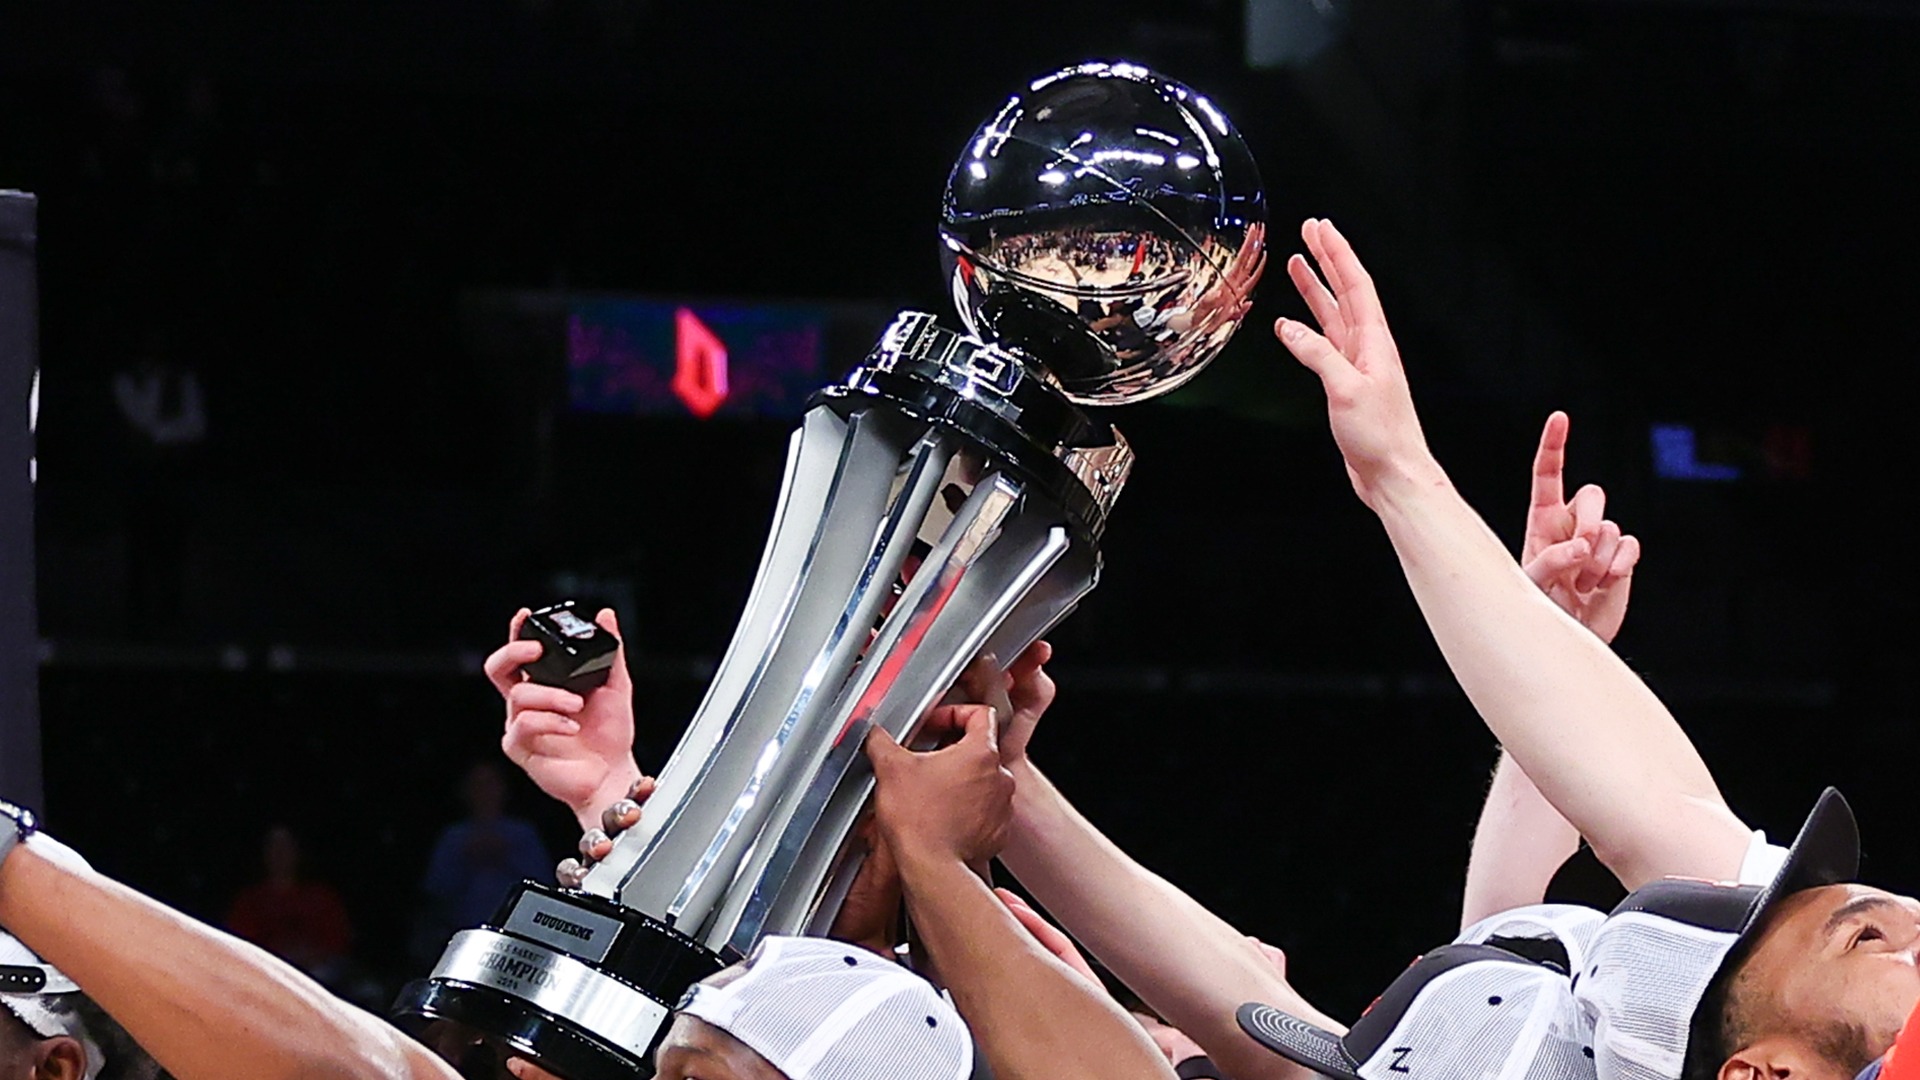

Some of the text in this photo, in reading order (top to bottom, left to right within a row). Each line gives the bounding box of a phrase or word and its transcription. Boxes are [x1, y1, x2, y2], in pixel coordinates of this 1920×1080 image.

[533, 911, 594, 941] DUQUESNE
[478, 951, 562, 991] CHAMPION
[1388, 1046, 1413, 1074] Z
